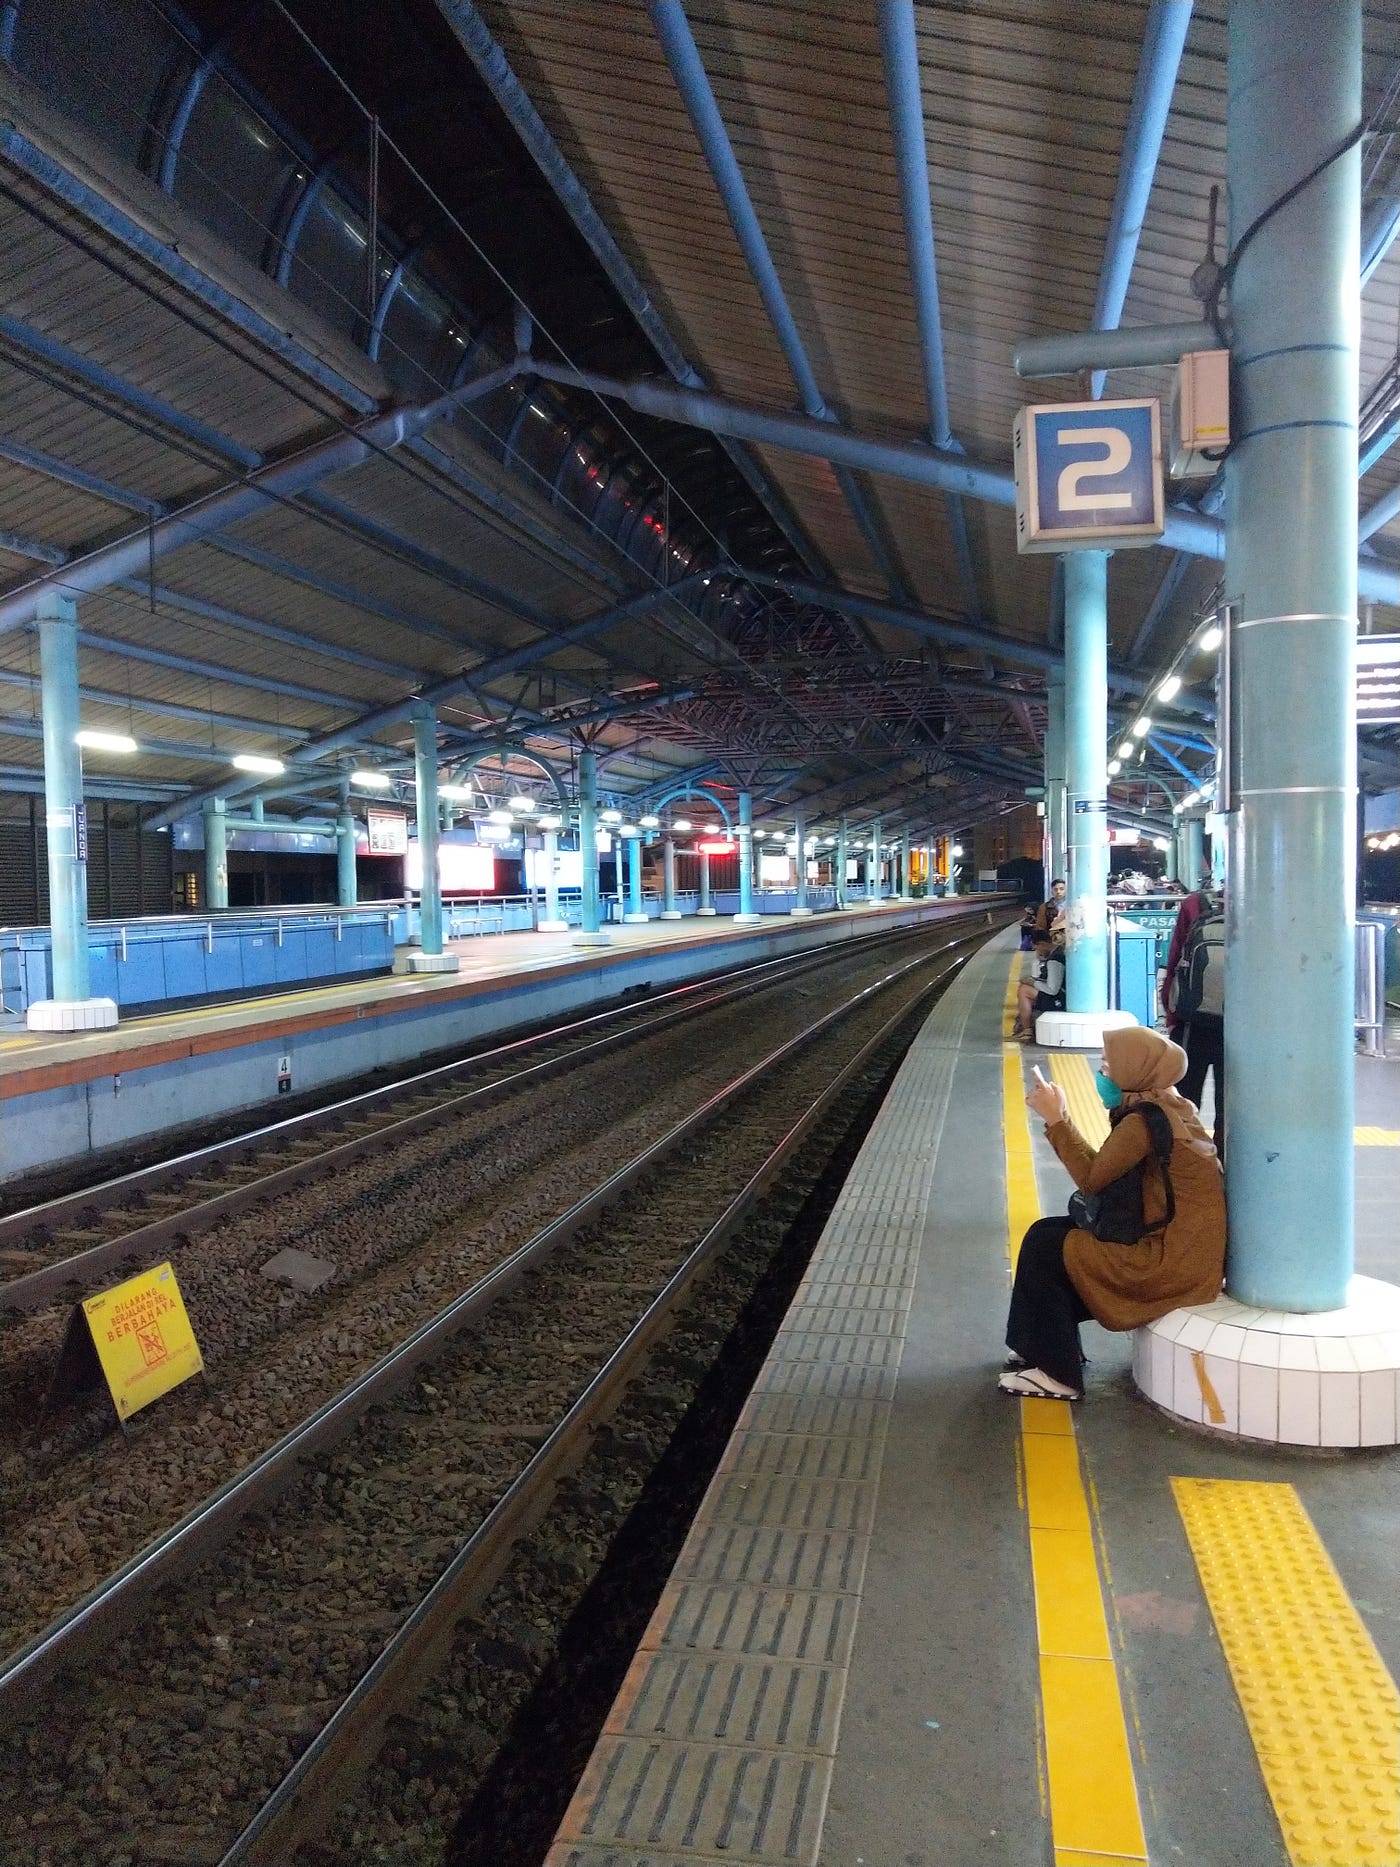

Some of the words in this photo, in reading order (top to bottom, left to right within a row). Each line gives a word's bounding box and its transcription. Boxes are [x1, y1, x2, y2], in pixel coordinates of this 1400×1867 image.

[1057, 427, 1132, 512] 2
[78, 806, 86, 859] JUANDA
[1140, 917, 1177, 927] PASA
[281, 1058, 288, 1073] 4
[115, 1287, 158, 1314] DILARANG
[107, 1298, 176, 1343] BERBAHAYA
[111, 1303, 146, 1327] BERJALAN
